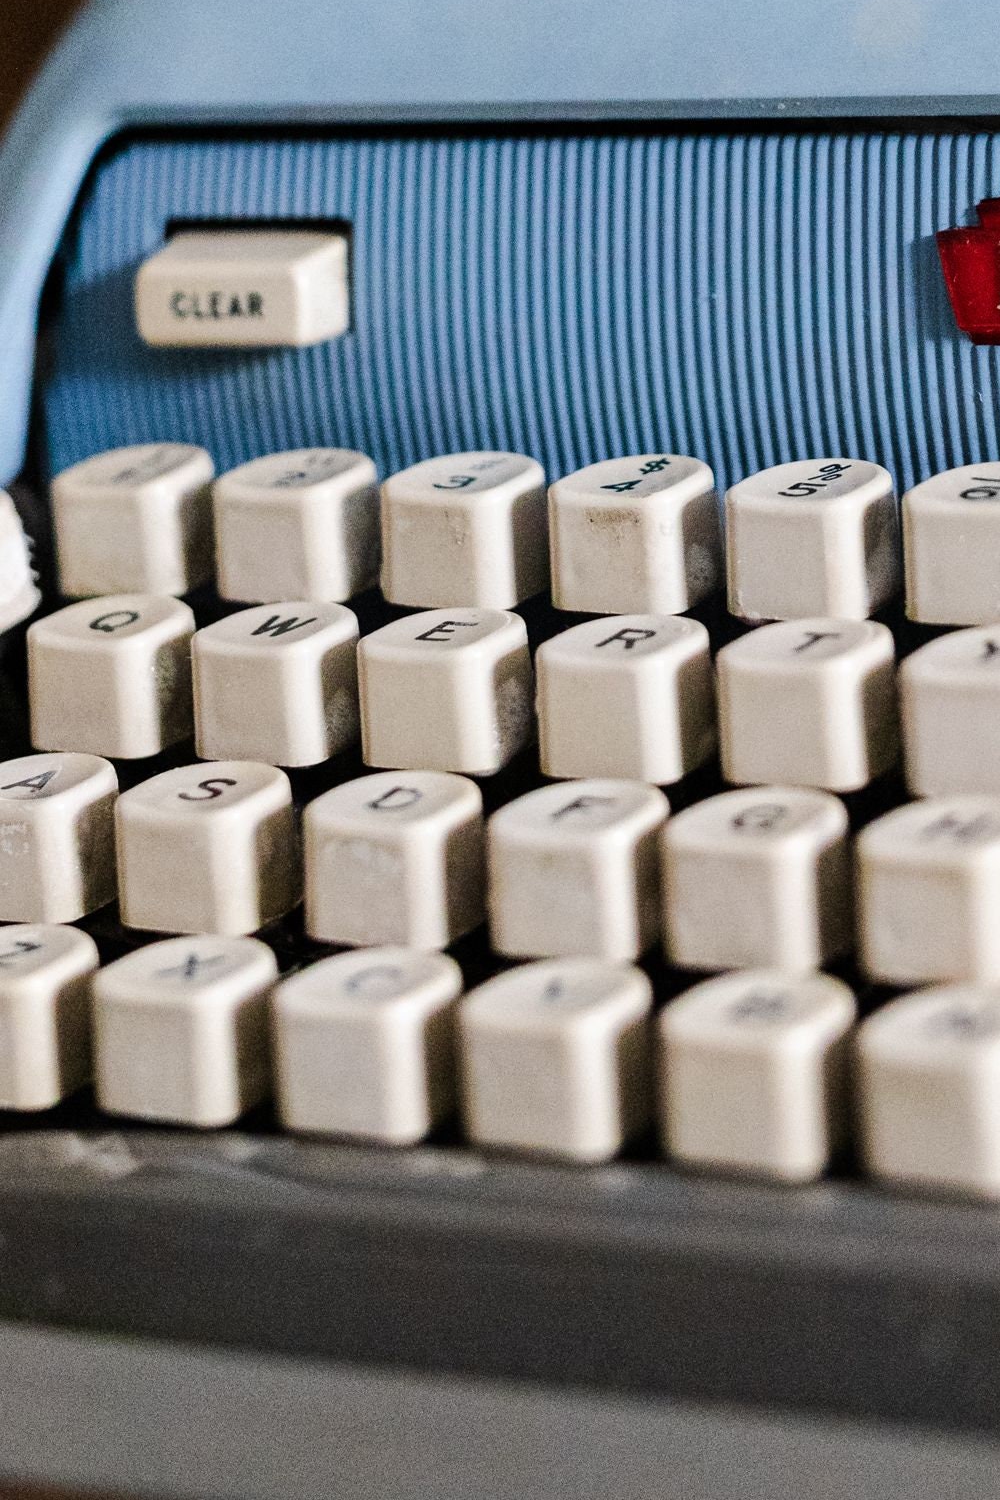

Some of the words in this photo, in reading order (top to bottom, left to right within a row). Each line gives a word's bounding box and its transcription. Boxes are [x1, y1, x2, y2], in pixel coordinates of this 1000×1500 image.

[169, 291, 264, 320] CLEAR
[89, 610, 140, 633] Q
[250, 613, 317, 638] W
[414, 620, 480, 643] E
[595, 627, 657, 650] R
[792, 631, 841, 654] T
[0, 770, 57, 793] A
[177, 777, 239, 802] S
[368, 786, 424, 811] D
